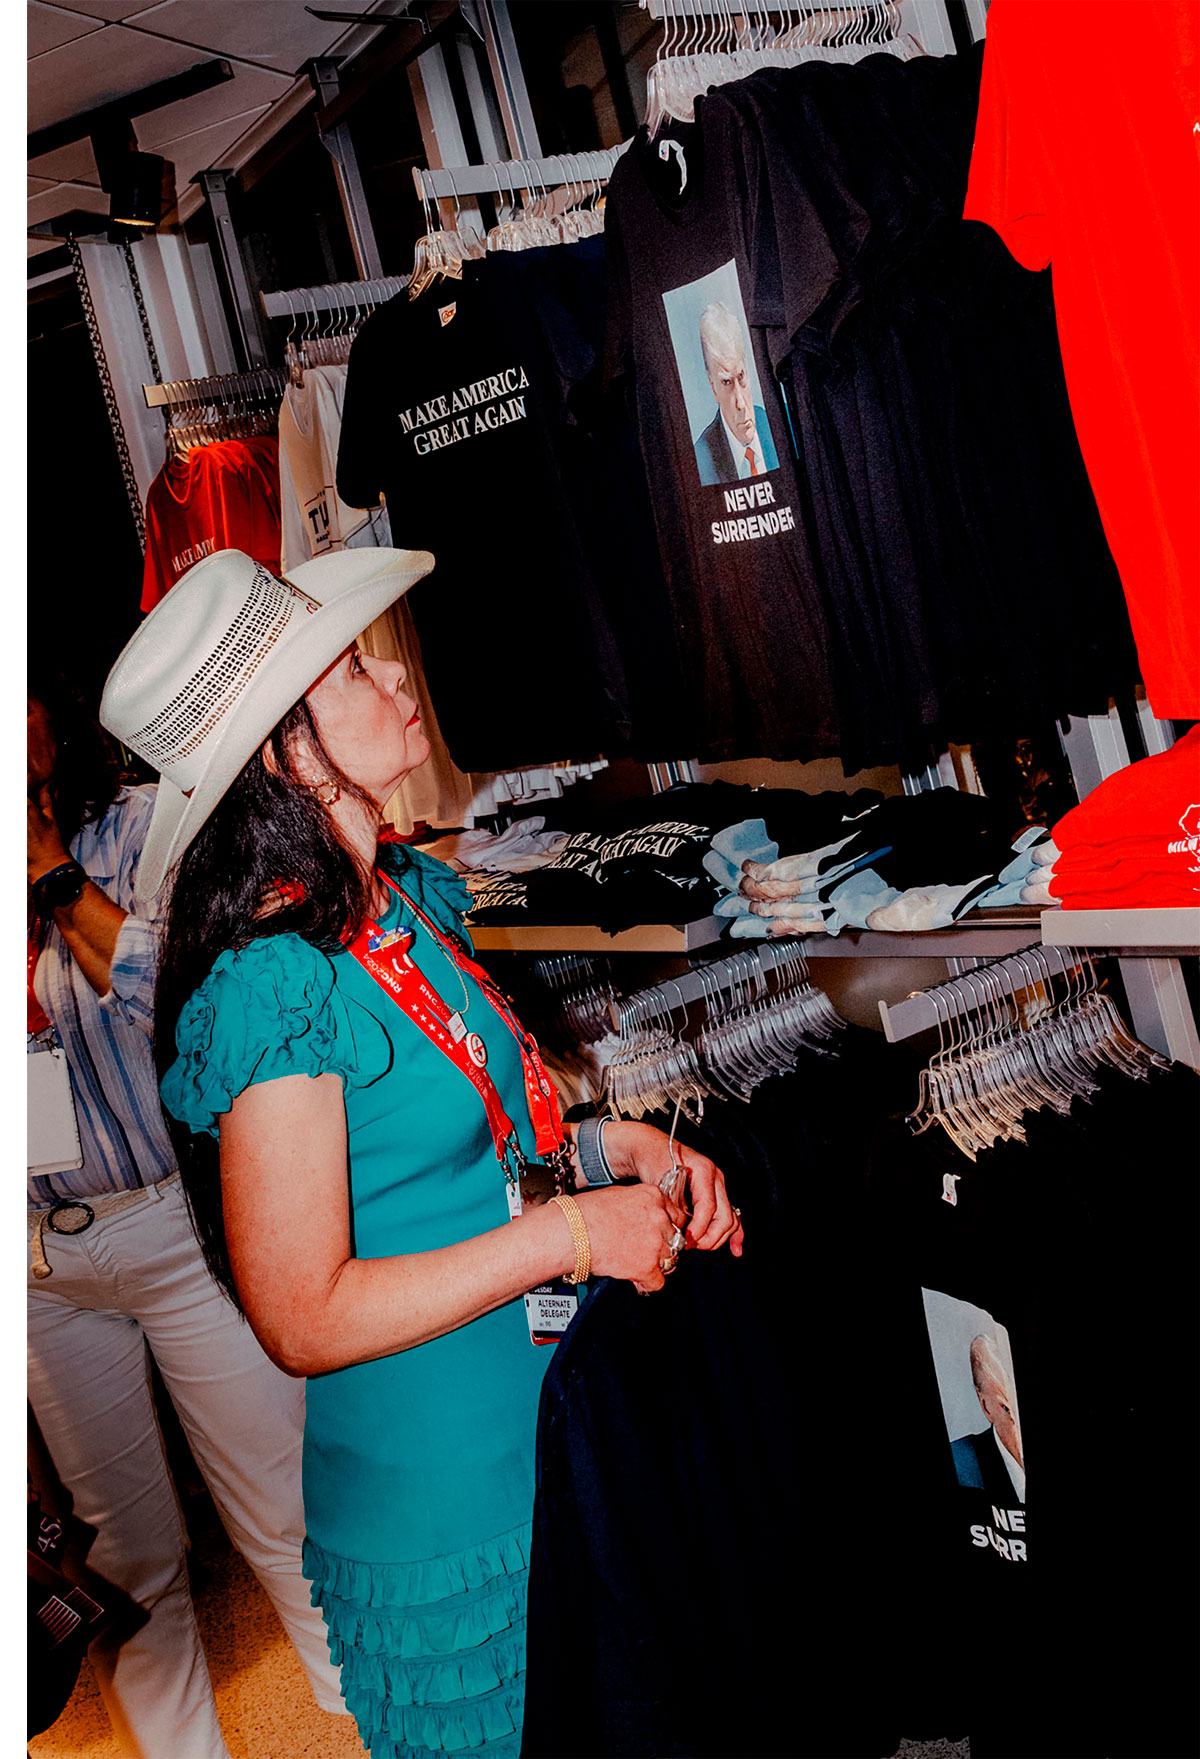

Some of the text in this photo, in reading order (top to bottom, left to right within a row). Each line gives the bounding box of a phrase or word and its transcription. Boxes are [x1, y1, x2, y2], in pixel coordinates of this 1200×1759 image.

[398, 366, 530, 434] MAKE AMERICA
[413, 395, 527, 455] GREAT AGAIN
[723, 481, 776, 513] NEVER
[711, 506, 796, 544] SURRENDER
[626, 834, 687, 857] AGAIN
[1167, 837, 1200, 854] MILW
[363, 953, 403, 994] RNC2024
[538, 1299, 571, 1309] ALTERNATE
[540, 1309, 571, 1319] DELEGATE
[37, 1516, 63, 1553] 45
[991, 1504, 1027, 1533] NE
